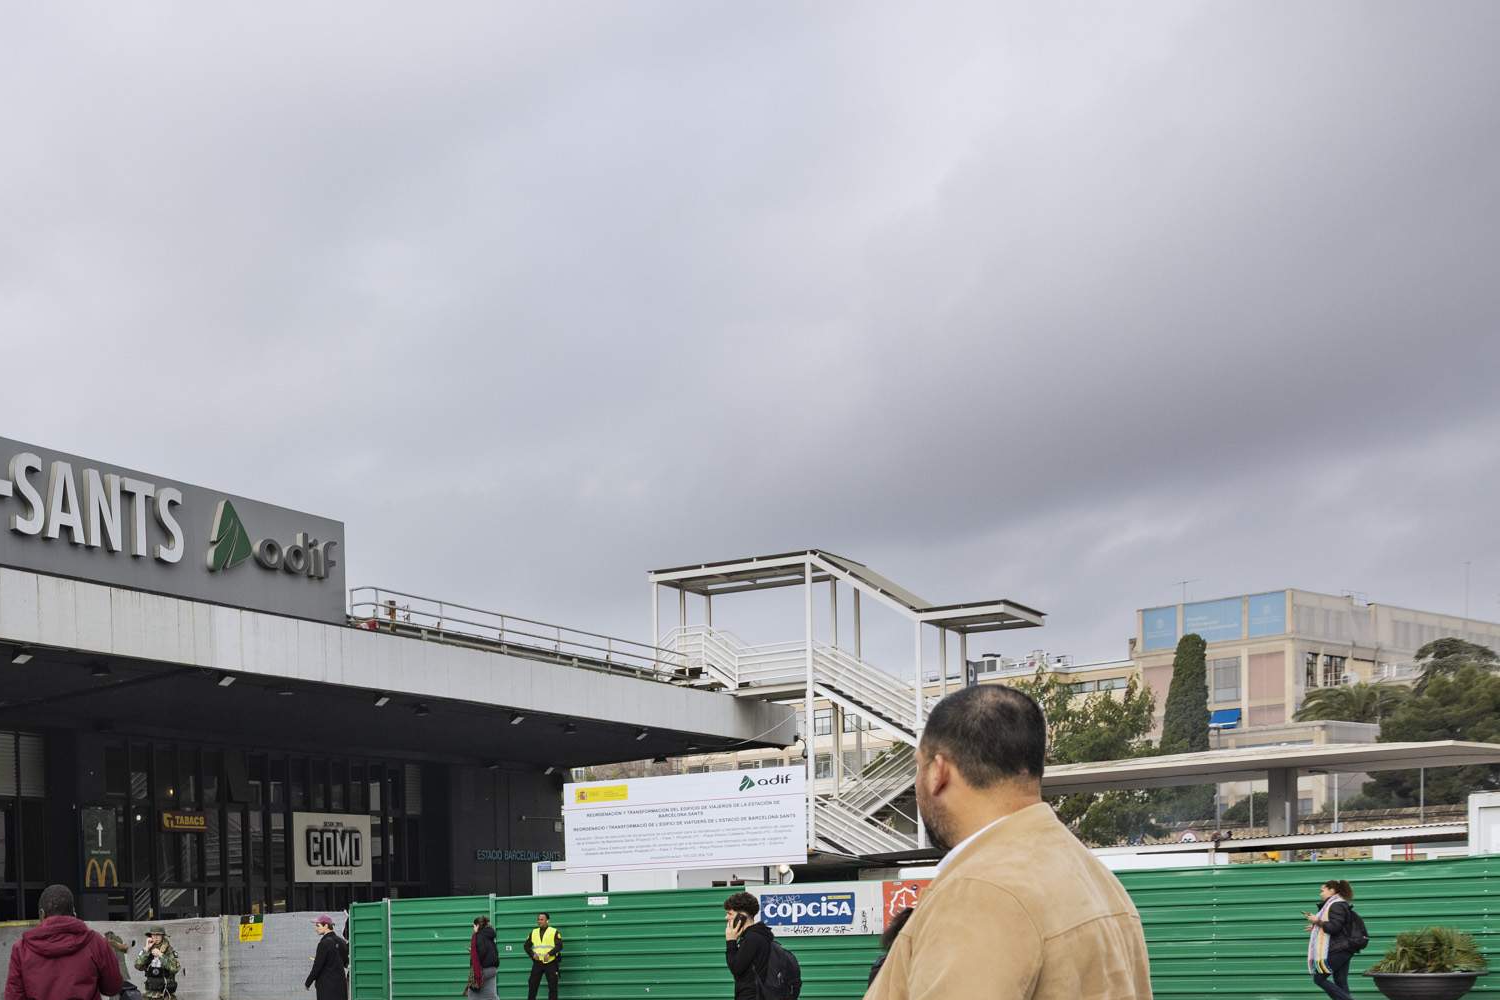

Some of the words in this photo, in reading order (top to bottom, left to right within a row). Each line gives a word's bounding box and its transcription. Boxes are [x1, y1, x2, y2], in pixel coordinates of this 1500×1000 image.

[252, 531, 338, 580] adif
[757, 773, 793, 786] adif
[174, 815, 205, 826] TABACS
[307, 828, 363, 868] COMO
